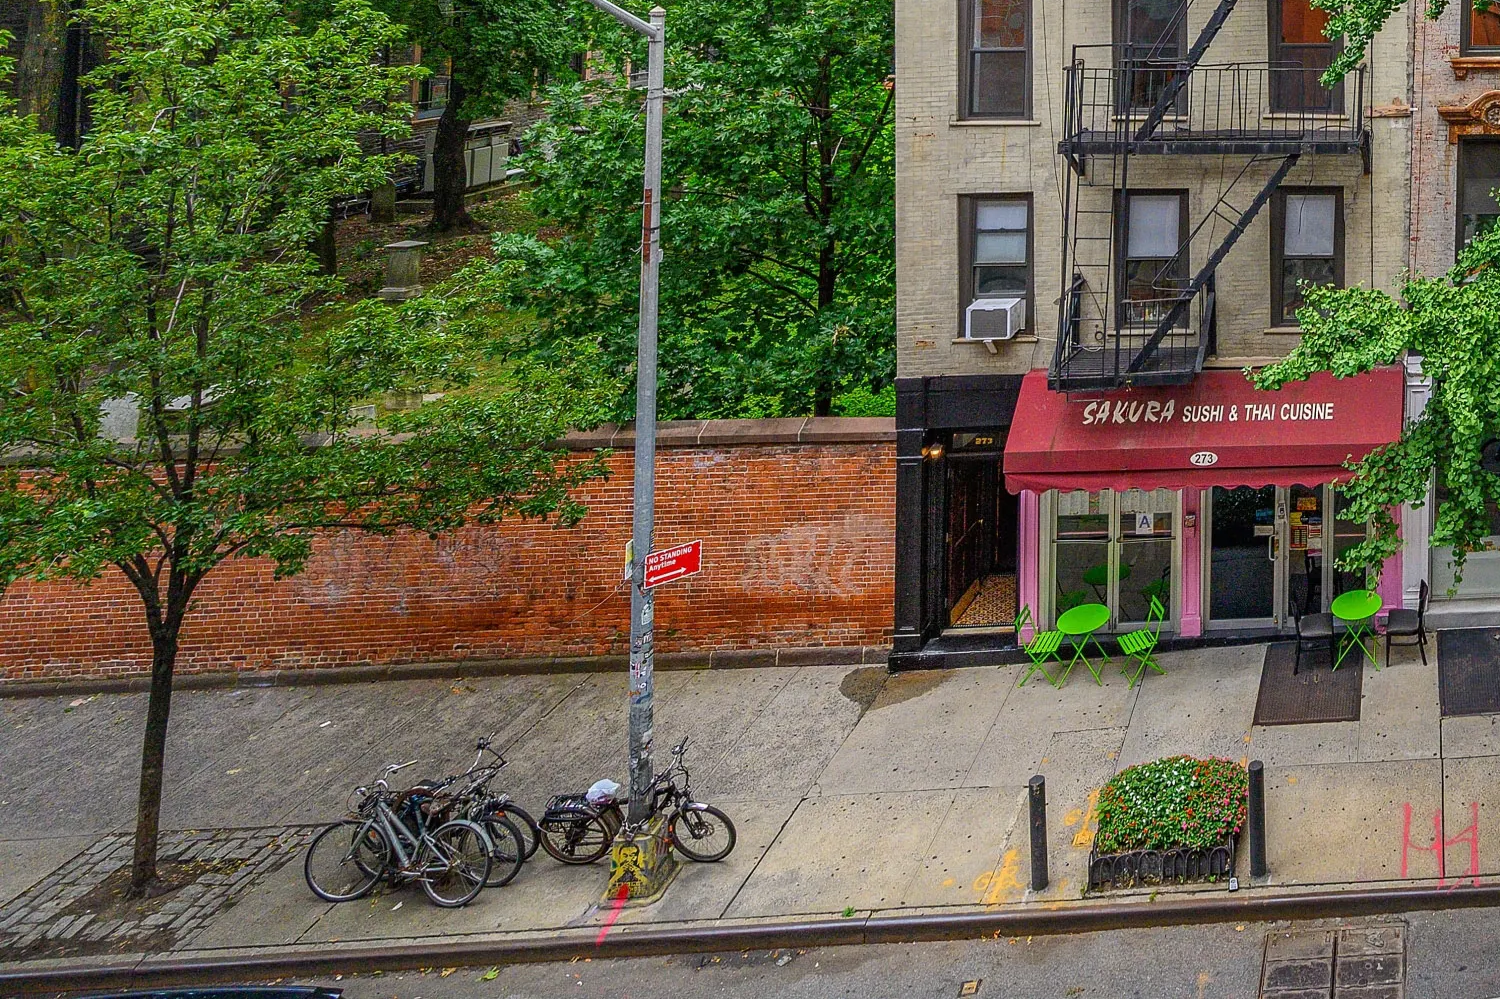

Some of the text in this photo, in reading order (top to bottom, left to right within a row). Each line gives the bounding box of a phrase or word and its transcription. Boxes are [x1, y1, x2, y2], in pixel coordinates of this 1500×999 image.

[1082, 399, 1334, 425] SAKURA SUSHI & THAI CUISINE
[975, 437, 993, 445] 273
[1194, 453, 1214, 465] 273
[1139, 515, 1151, 529] A
[648, 546, 693, 565] NO STANDING
[648, 559, 677, 572] Anytime
